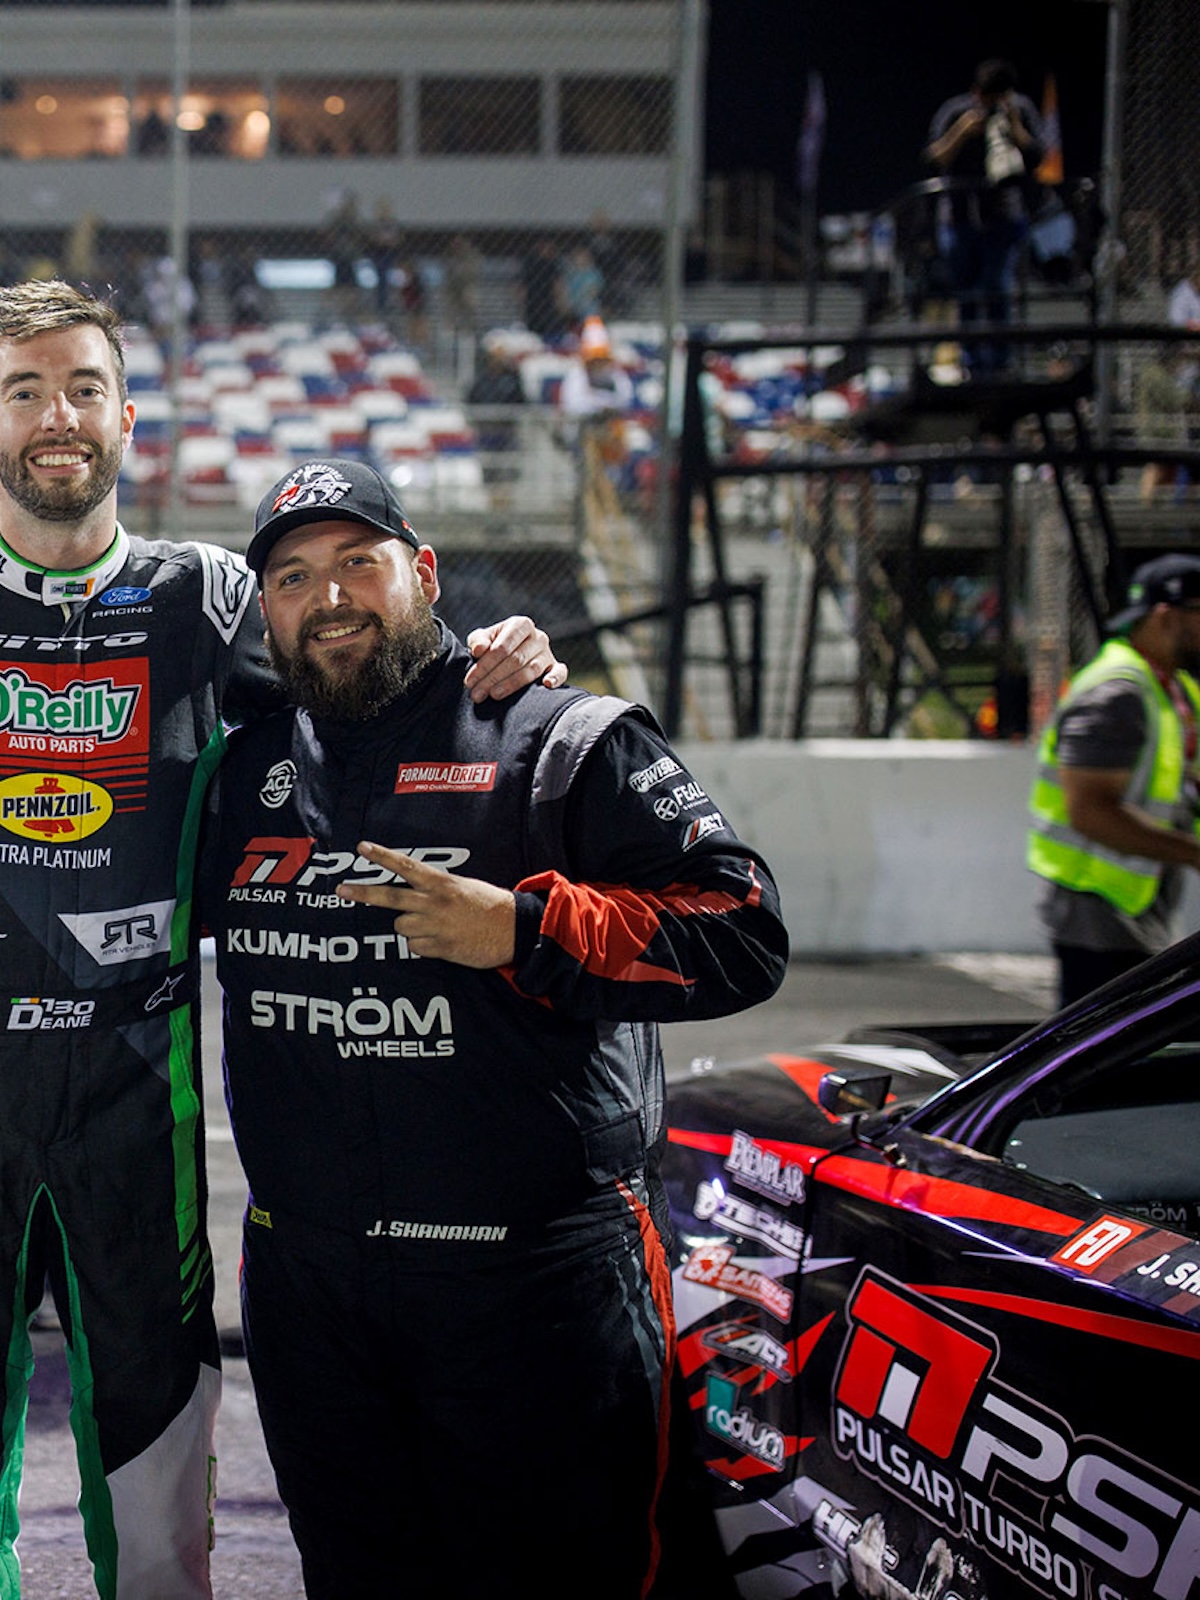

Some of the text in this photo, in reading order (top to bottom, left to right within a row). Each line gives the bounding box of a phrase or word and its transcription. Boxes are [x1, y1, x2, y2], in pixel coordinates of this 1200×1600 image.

[106, 591, 140, 603] Ford
[92, 606, 153, 619] RACING
[8, 735, 95, 753] AUTO PARTS
[261, 774, 294, 793] ACL
[398, 766, 493, 783] FORMULA DRIFT
[672, 781, 706, 807] FEAL
[33, 847, 112, 870] PLATINUM
[228, 888, 287, 904] PULSAR
[227, 928, 422, 963] KUMHO TI
[6, 1004, 93, 1031] DEANE
[41, 998, 96, 1016] 130
[250, 987, 453, 1038] STRÖM
[337, 1039, 456, 1060] WHEELS
[366, 1210, 508, 1242] J.SHANAHAN
[1059, 1219, 1133, 1267] FD
[706, 1405, 785, 1462] radium
[836, 1407, 956, 1518] PULSAR
[963, 1491, 1078, 1599] TURBO
